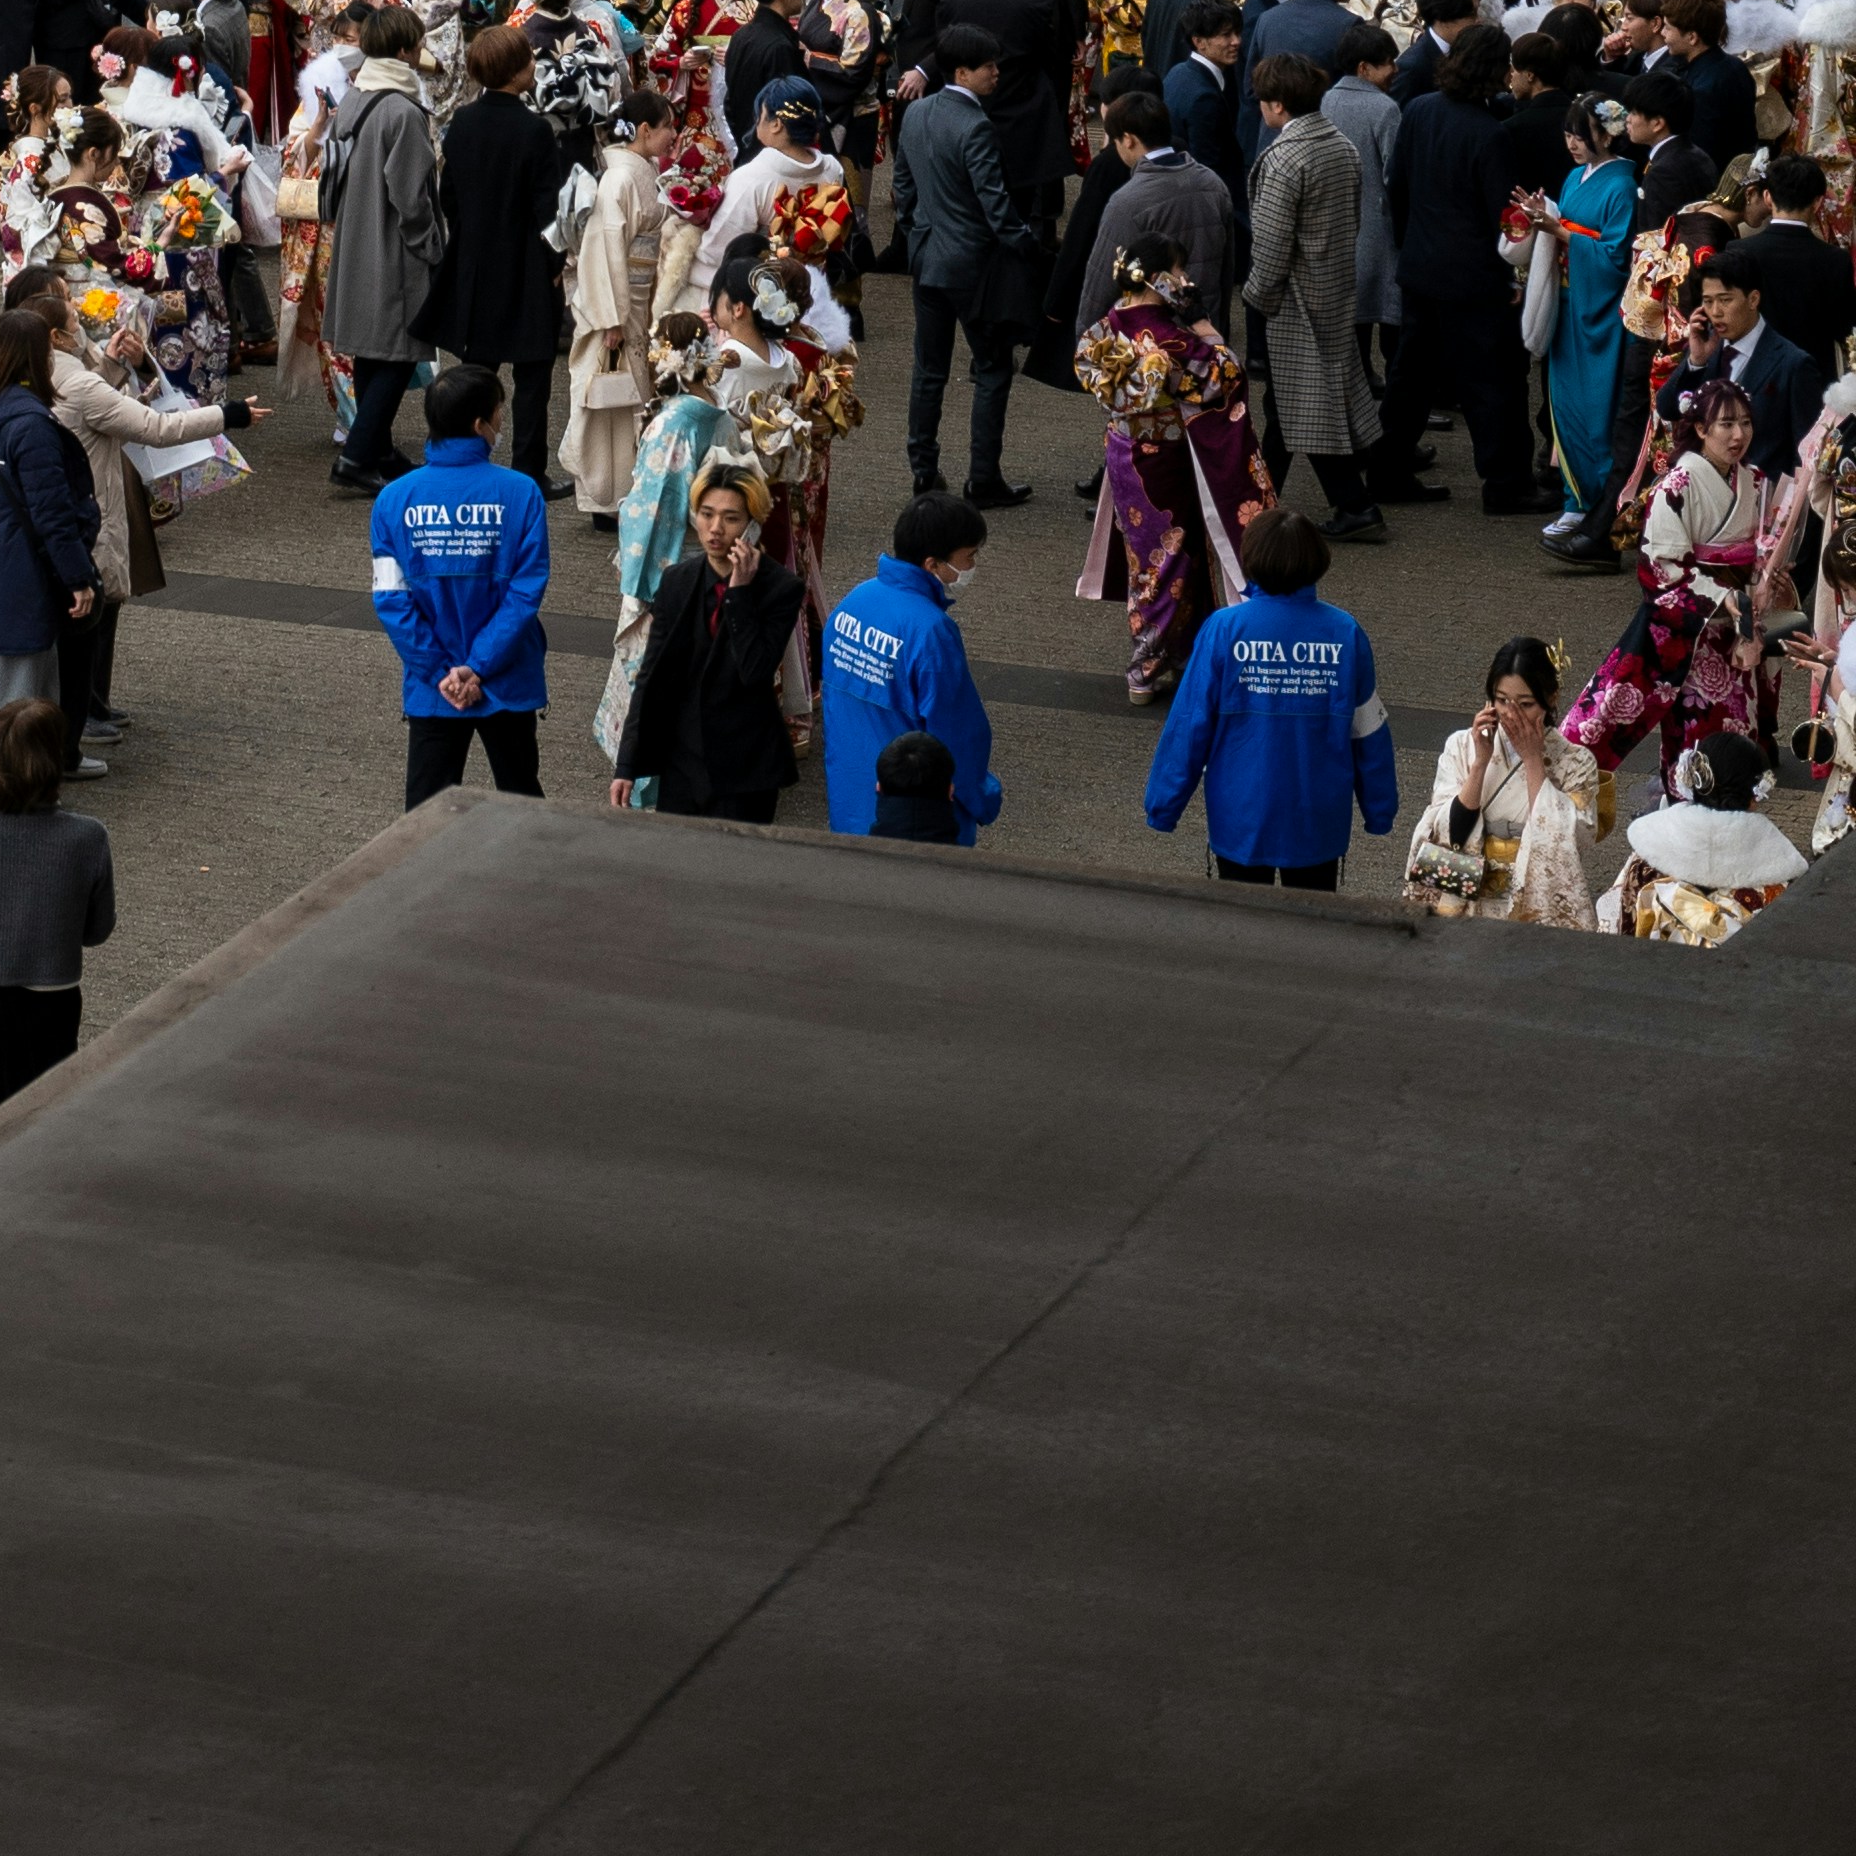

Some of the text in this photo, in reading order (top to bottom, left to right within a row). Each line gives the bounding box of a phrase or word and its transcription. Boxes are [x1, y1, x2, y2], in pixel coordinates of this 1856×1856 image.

[404, 504, 506, 528] OITA CITY
[834, 611, 904, 660] OITA CITY
[1233, 640, 1343, 665] OITA CITY
[1242, 666, 1337, 677] All human beings are
[1248, 684, 1279, 695] dignity
[1281, 686, 1298, 694] and
[1262, 676, 1281, 684] free
[1282, 677, 1301, 685] and
[1302, 677, 1327, 686] equal
[1329, 678, 1339, 686] in
